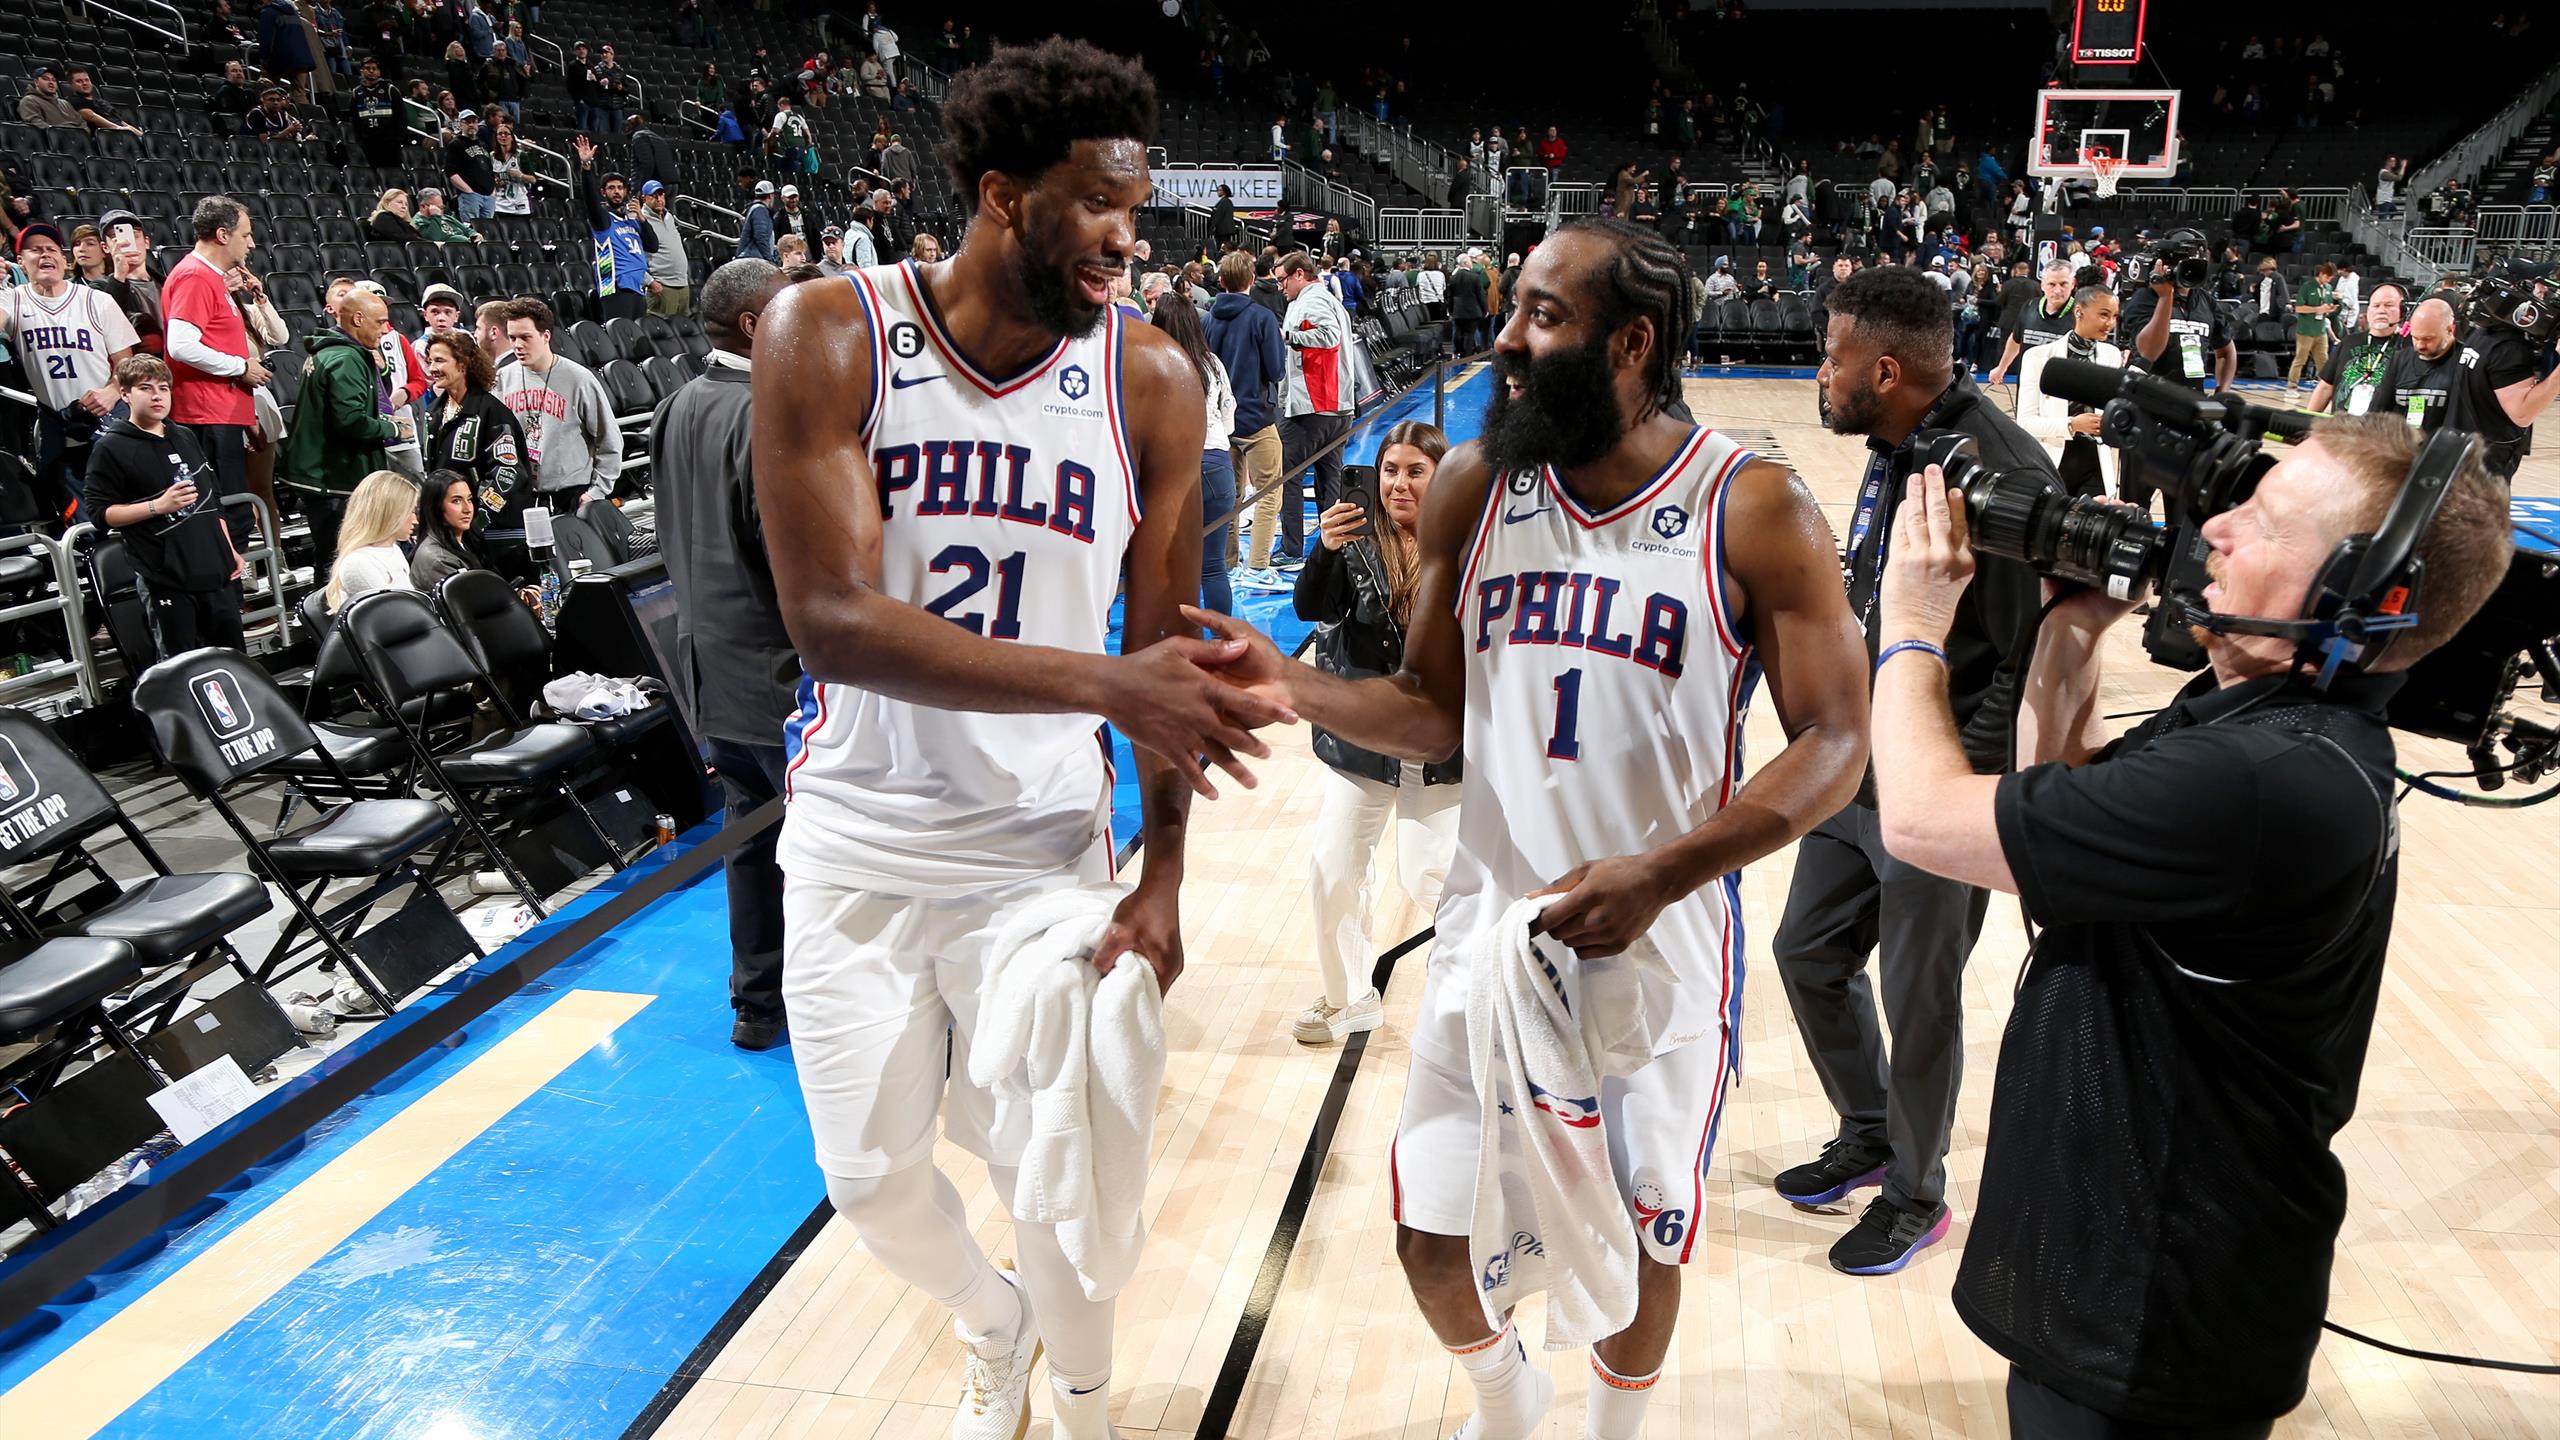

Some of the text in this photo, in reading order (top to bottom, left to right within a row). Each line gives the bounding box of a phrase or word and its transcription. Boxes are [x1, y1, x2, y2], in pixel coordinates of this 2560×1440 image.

[2094, 49, 2135, 57] TISSOT
[625, 237, 642, 255] 34
[21, 326, 94, 353] PHILA
[897, 326, 916, 354] 6
[47, 354, 78, 379] 21
[504, 387, 567, 422] WISCONSIN
[1043, 403, 1104, 419] crypto.com
[873, 440, 1096, 544] PHILA
[1514, 471, 1534, 491] 6
[1631, 539, 1697, 558] crypto.com
[924, 544, 1026, 640] 21
[1476, 571, 1688, 679] PHILA
[1547, 667, 1583, 761] 1
[229, 736, 259, 763] THE
[250, 727, 276, 755] APP
[10, 806, 47, 839] THE
[36, 793, 69, 827] APP
